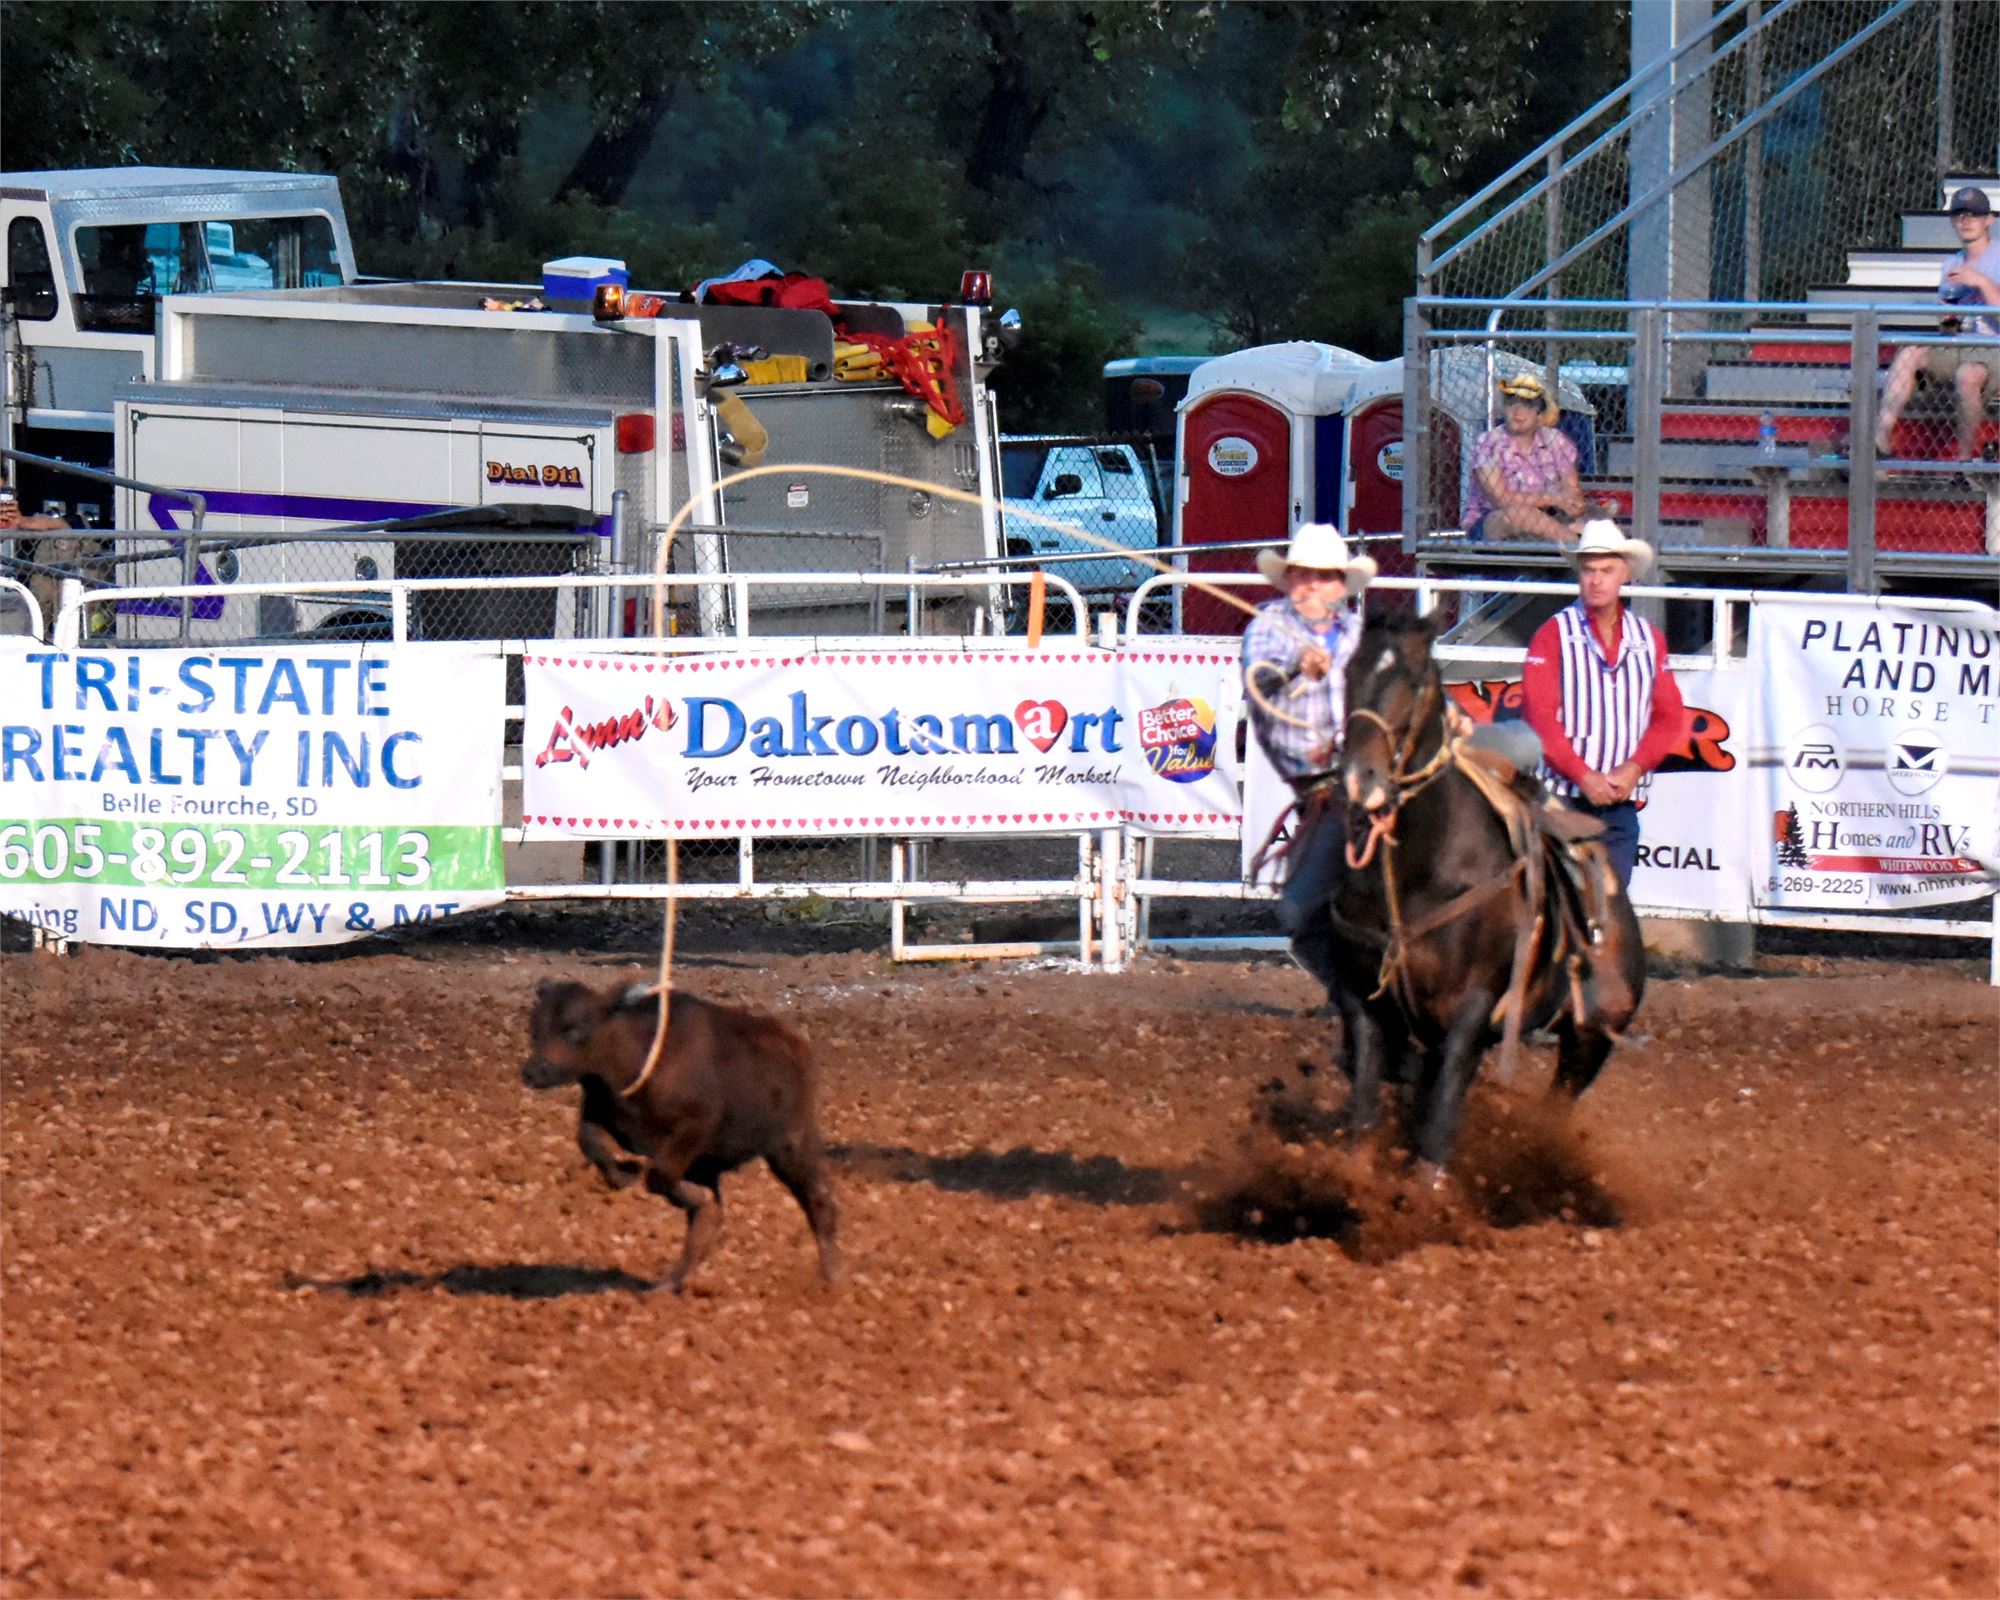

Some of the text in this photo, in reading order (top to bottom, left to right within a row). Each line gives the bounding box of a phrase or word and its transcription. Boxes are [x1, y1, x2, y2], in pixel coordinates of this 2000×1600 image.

[487, 462, 583, 488] Dial 911
[1801, 620, 2000, 659] PLATINU
[26, 653, 390, 716] TRI-STATE
[1842, 658, 2000, 697] AND M
[680, 690, 1124, 758] Dakotamart
[1142, 707, 1194, 727] Better
[1825, 696, 1948, 722] HORSE
[1143, 723, 1198, 743] Choice
[2, 725, 424, 790] REALTY INC
[686, 765, 1120, 792] Your Hometown Neighborhood Market!
[102, 793, 318, 819] Belle Fourche, SD
[1809, 801, 1941, 819] NORTHERN HILLS
[0, 823, 432, 887] 605-892-2113
[1809, 820, 1970, 856] Homes and RVs
[100, 897, 168, 939] ND,
[184, 900, 248, 940] SD,
[262, 902, 331, 936] WY
[345, 902, 376, 931] &
